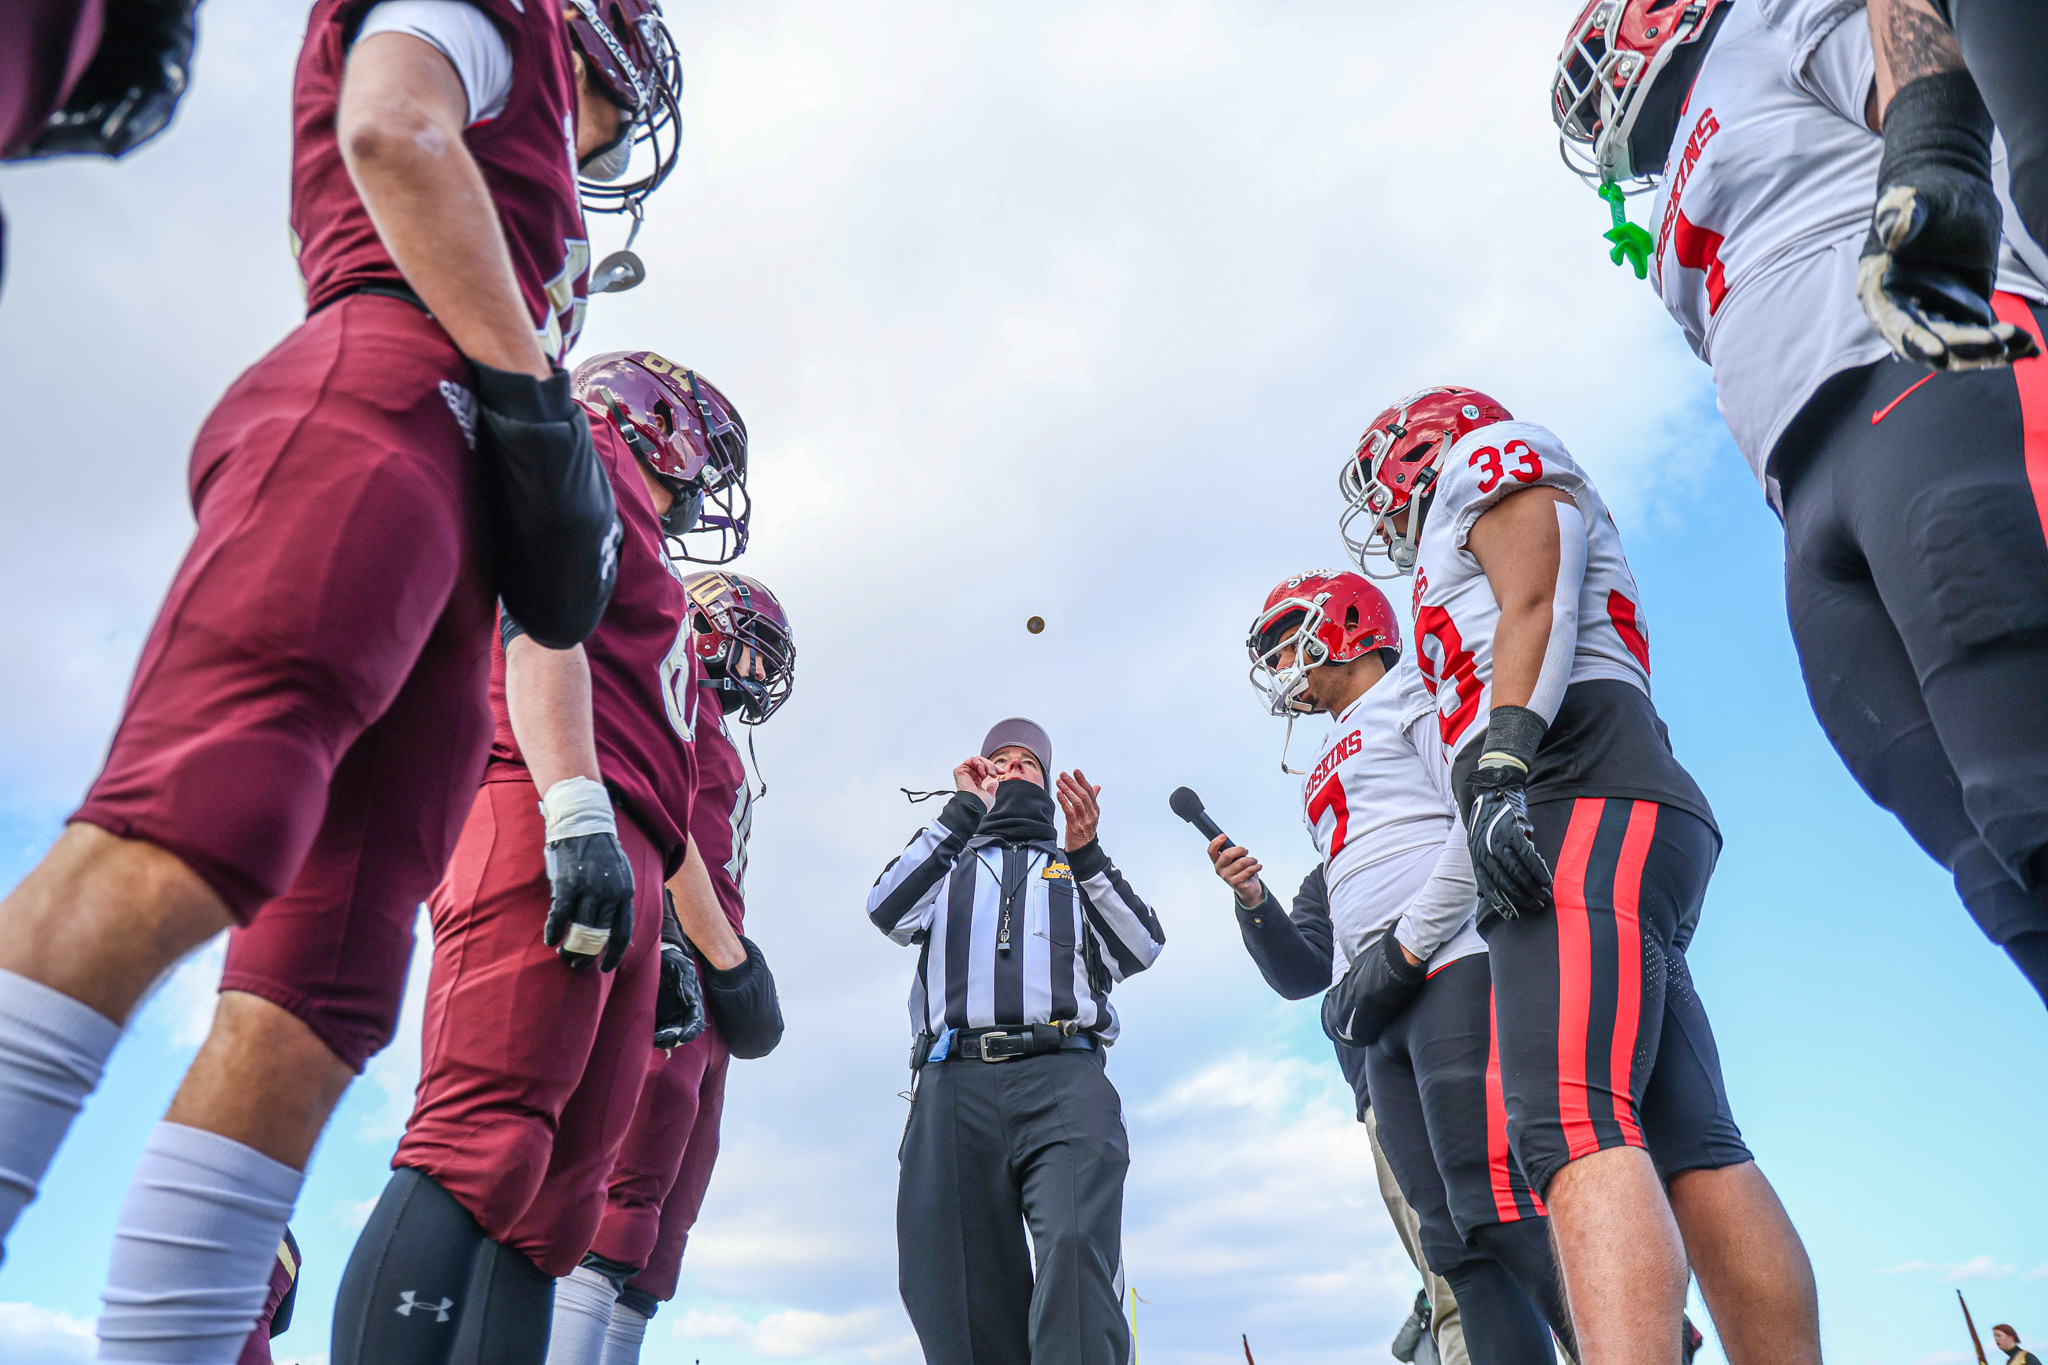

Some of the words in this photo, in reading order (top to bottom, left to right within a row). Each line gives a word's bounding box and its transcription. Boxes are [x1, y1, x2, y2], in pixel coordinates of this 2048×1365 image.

[592, 19, 646, 92] RMOUR
[1468, 439, 1543, 494] 33
[1308, 771, 1350, 863] 7
